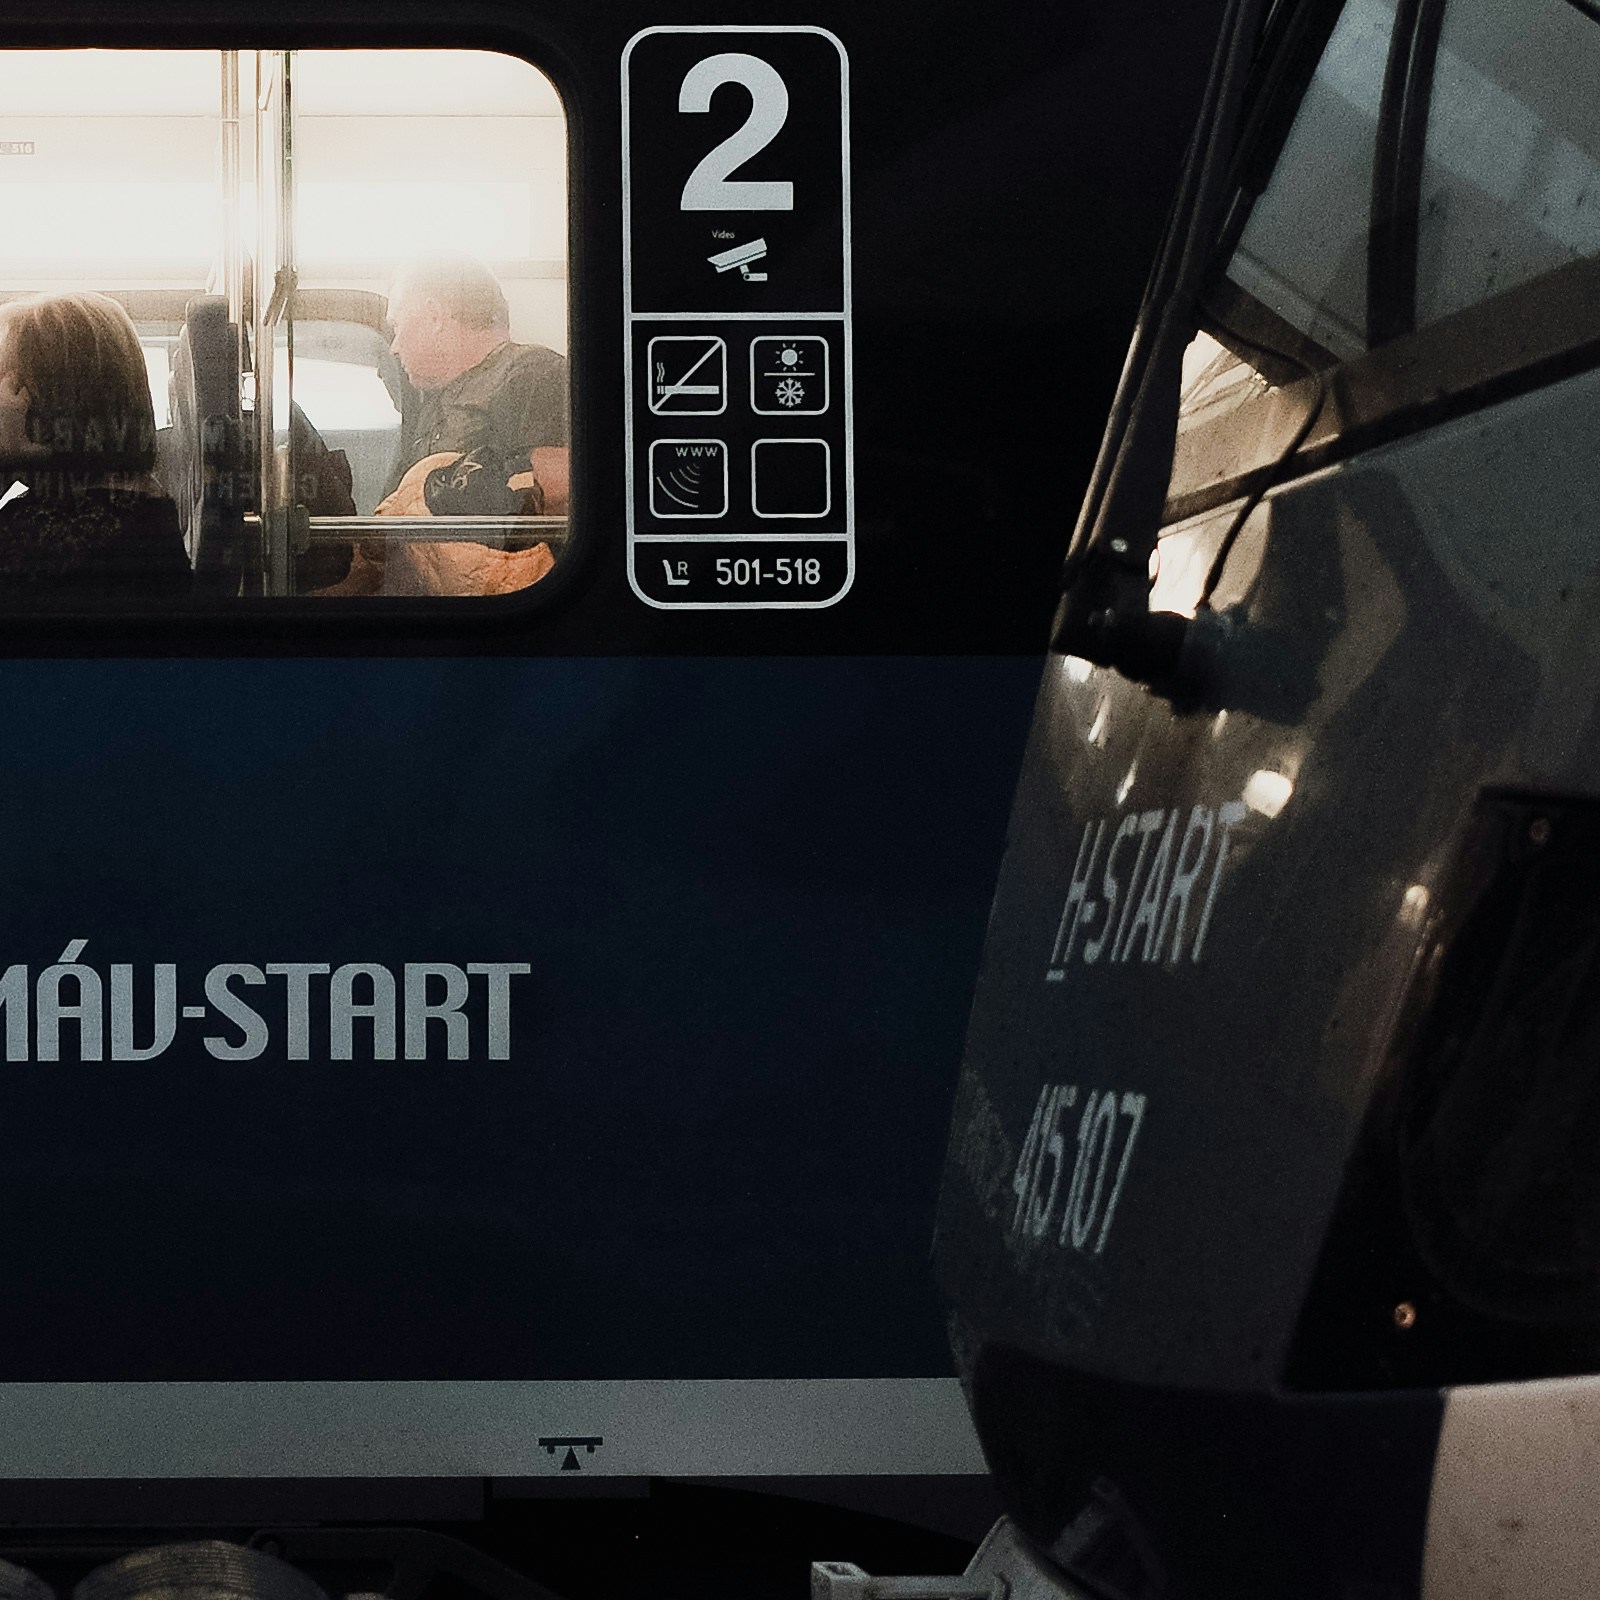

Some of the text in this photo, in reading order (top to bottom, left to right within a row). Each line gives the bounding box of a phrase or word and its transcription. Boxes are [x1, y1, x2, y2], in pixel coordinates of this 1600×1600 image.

[678, 53, 794, 211] 2
[711, 229, 736, 239] Video
[716, 558, 821, 586] 501-518
